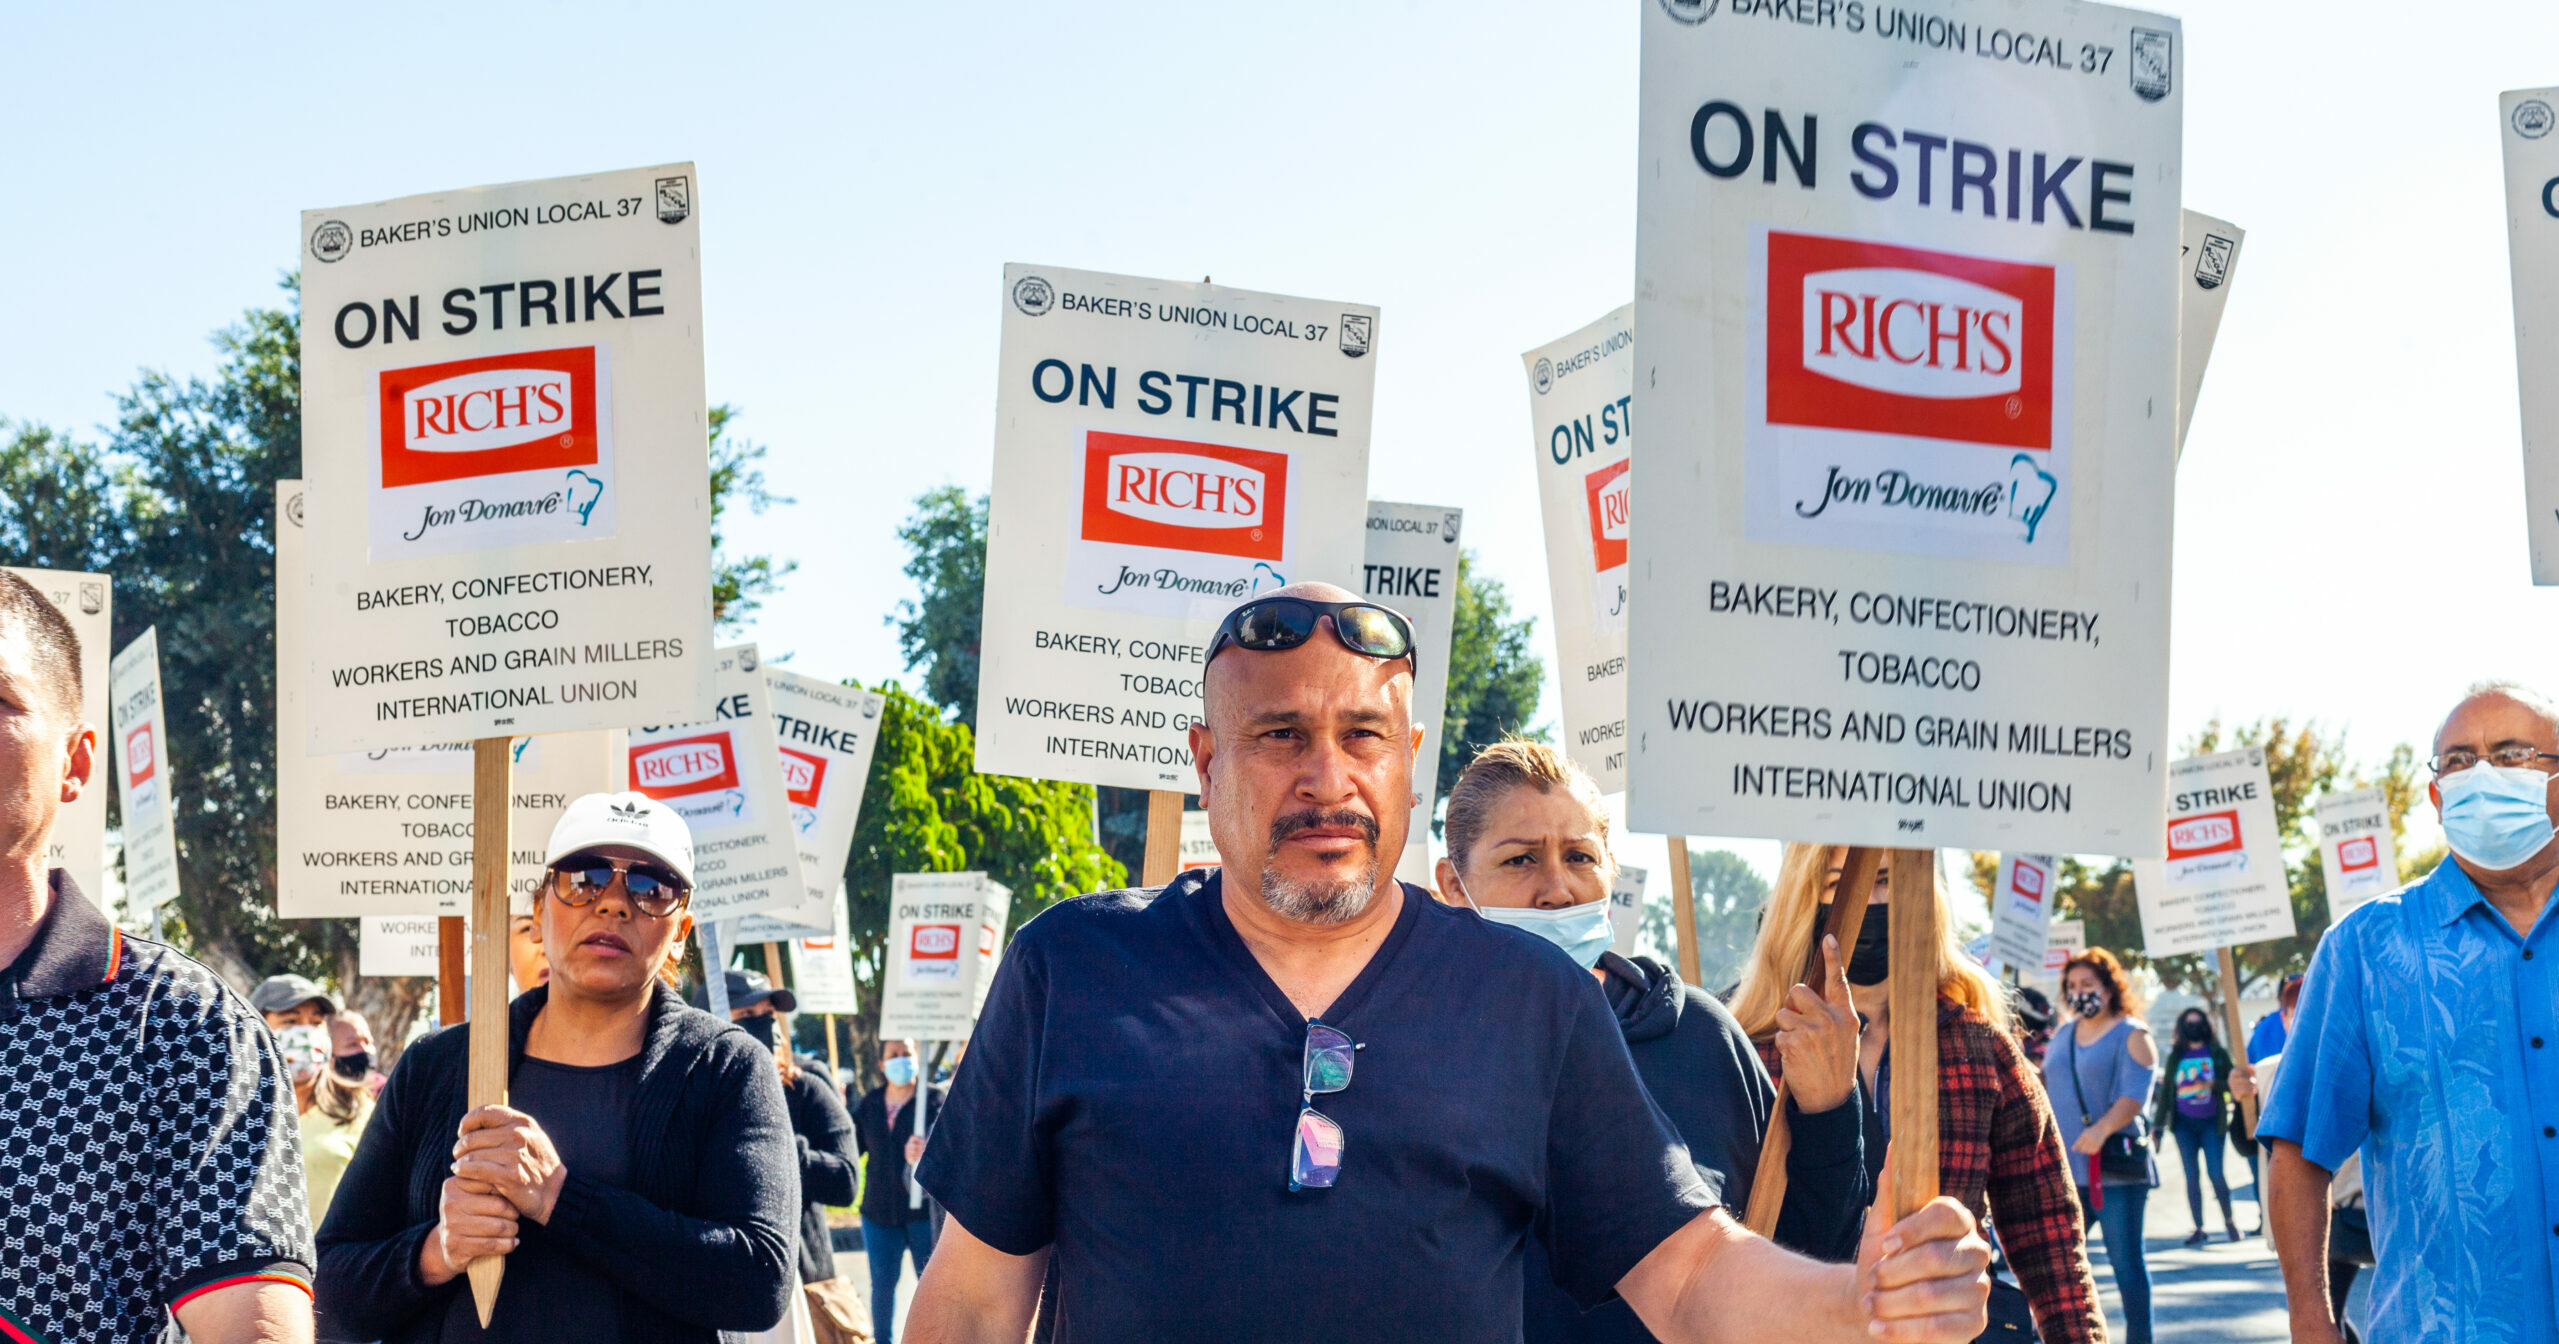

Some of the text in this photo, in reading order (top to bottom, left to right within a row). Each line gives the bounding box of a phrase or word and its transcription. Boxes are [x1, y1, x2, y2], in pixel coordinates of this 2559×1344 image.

[1876, 7, 1966, 55] UNION
[1975, 28, 2074, 71] LOCAL
[2080, 45, 2115, 77] 37
[1690, 100, 2136, 236] ON STRIKE
[361, 218, 451, 248] BAKER'S
[458, 207, 529, 234] UNION
[537, 200, 612, 225] LOCAL
[617, 197, 643, 217] 37
[334, 268, 665, 350] ON STRIKE
[1062, 293, 1152, 321] BAKER'S
[1158, 305, 1227, 330] UNION
[1233, 313, 1300, 339] LOCAL
[1304, 323, 1329, 343] 37
[1814, 287, 2013, 376] RICH'S
[1556, 345, 1600, 379] BAKER'S
[1601, 328, 1633, 358] UNION
[413, 382, 566, 440] RICH'S
[1032, 358, 1341, 438] ON STRIKE
[1551, 414, 1595, 465] ON
[1115, 463, 1257, 517] RICH'S
[1795, 465, 1871, 519] Jon
[403, 504, 456, 541] Jon
[1390, 519, 1424, 533] LOCAL
[1425, 522, 1439, 534] 37
[357, 565, 655, 611] BAKERY, CONFECTIONERY,
[1098, 565, 1150, 595] Jon
[1364, 564, 1441, 598] TRIKE
[1610, 585, 1627, 616] Jo
[1710, 581, 2101, 649] BAKERY, CONFECTIONERY,
[445, 609, 559, 639] TOBACCO
[1035, 631, 1122, 660] BAKERY,
[332, 638, 684, 688] WORKERS AND GRAIN MILLERS
[1587, 656, 1626, 682] BAKER
[1838, 649, 1981, 692] TOBACCO
[376, 680, 638, 722] INTERNATIONAL UNION
[1120, 674, 1204, 700] TOBACC
[1006, 697, 1114, 725] WORKERS
[1120, 709, 1166, 730] AND
[1668, 700, 2132, 760] WORKERS AND GRAIN MILLERS
[773, 713, 859, 755] TRIKE
[1580, 720, 1625, 746] WORKE
[643, 748, 720, 781] RICH'S
[1047, 736, 1195, 767] INTERNATION
[325, 794, 400, 812] BAKERY,
[1733, 764, 2072, 813] INTERNATIONAL UNION
[2176, 782, 2258, 812] STRIKE
[401, 823, 474, 839] TOBACC
[2342, 813, 2383, 834] STRIKE
[303, 851, 397, 867] WORKERS
[404, 852, 443, 867] AND
[340, 879, 474, 896] INTERNATIONA
[701, 866, 788, 892] GRAIN MILLERS
[732, 888, 770, 904] UNION
[381, 921, 437, 935] WORKE
[900, 904, 920, 919] ON
[923, 903, 975, 919] STRIKE
